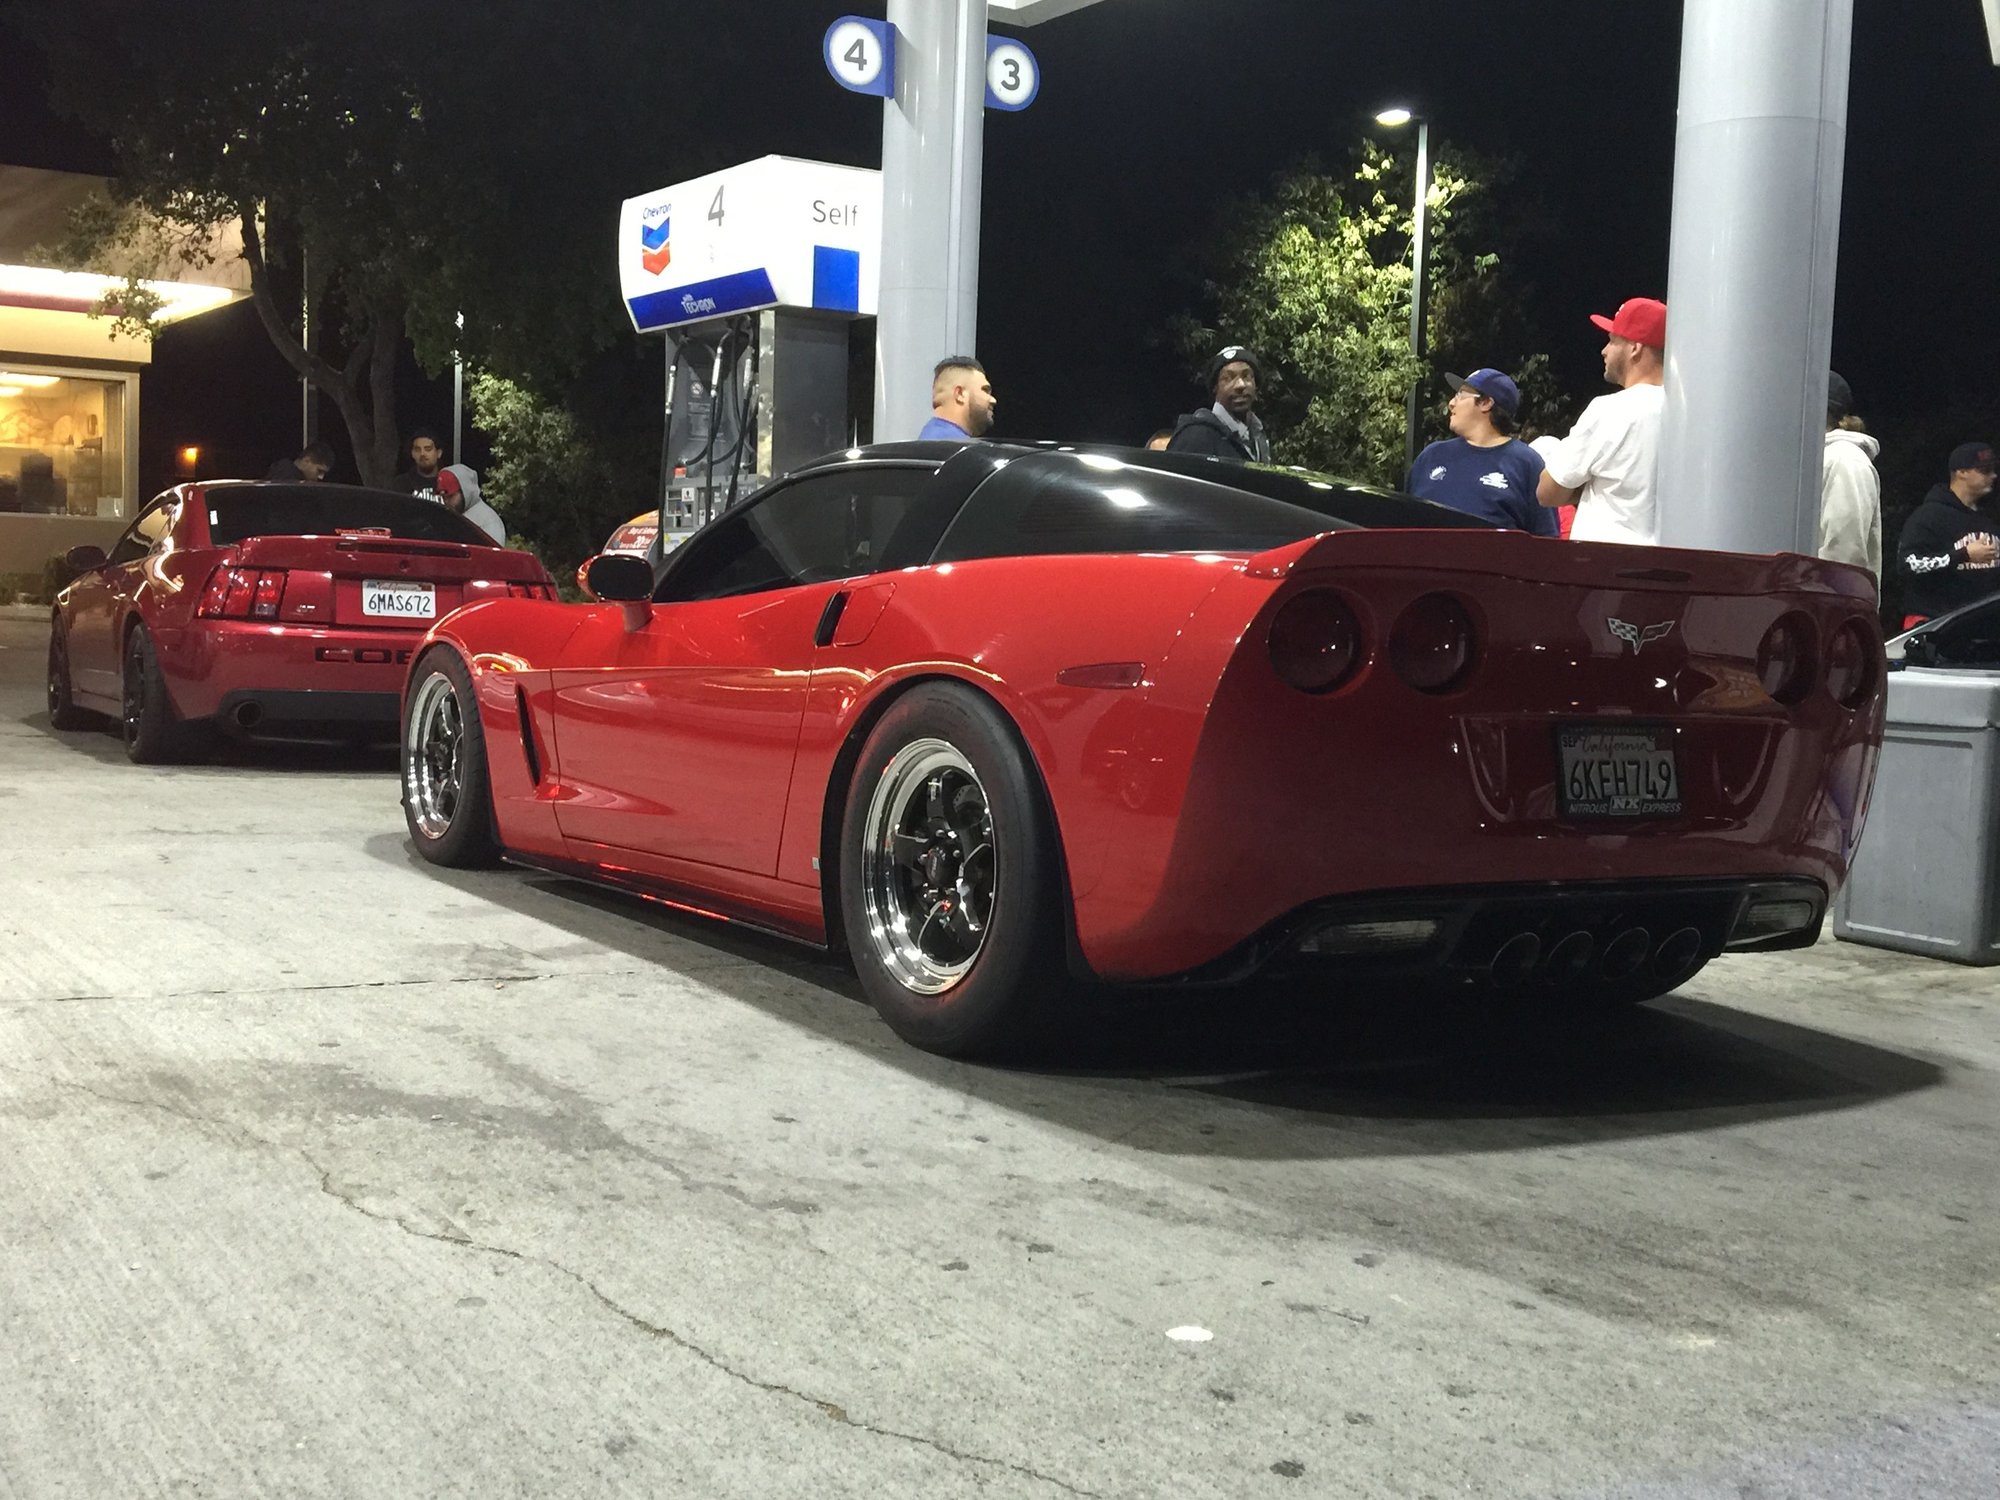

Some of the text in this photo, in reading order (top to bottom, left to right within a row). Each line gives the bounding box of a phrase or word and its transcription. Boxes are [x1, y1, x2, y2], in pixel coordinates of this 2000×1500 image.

[844, 38, 867, 71] 4
[1000, 58, 1020, 91] 3
[642, 203, 672, 220] Chevron
[707, 184, 725, 227] 4
[812, 199, 858, 227] Self
[368, 593, 431, 613] 6MAS672
[1570, 760, 1672, 800] 6KEH749
[1569, 798, 1682, 814] NITROUS NX EXPRESS
